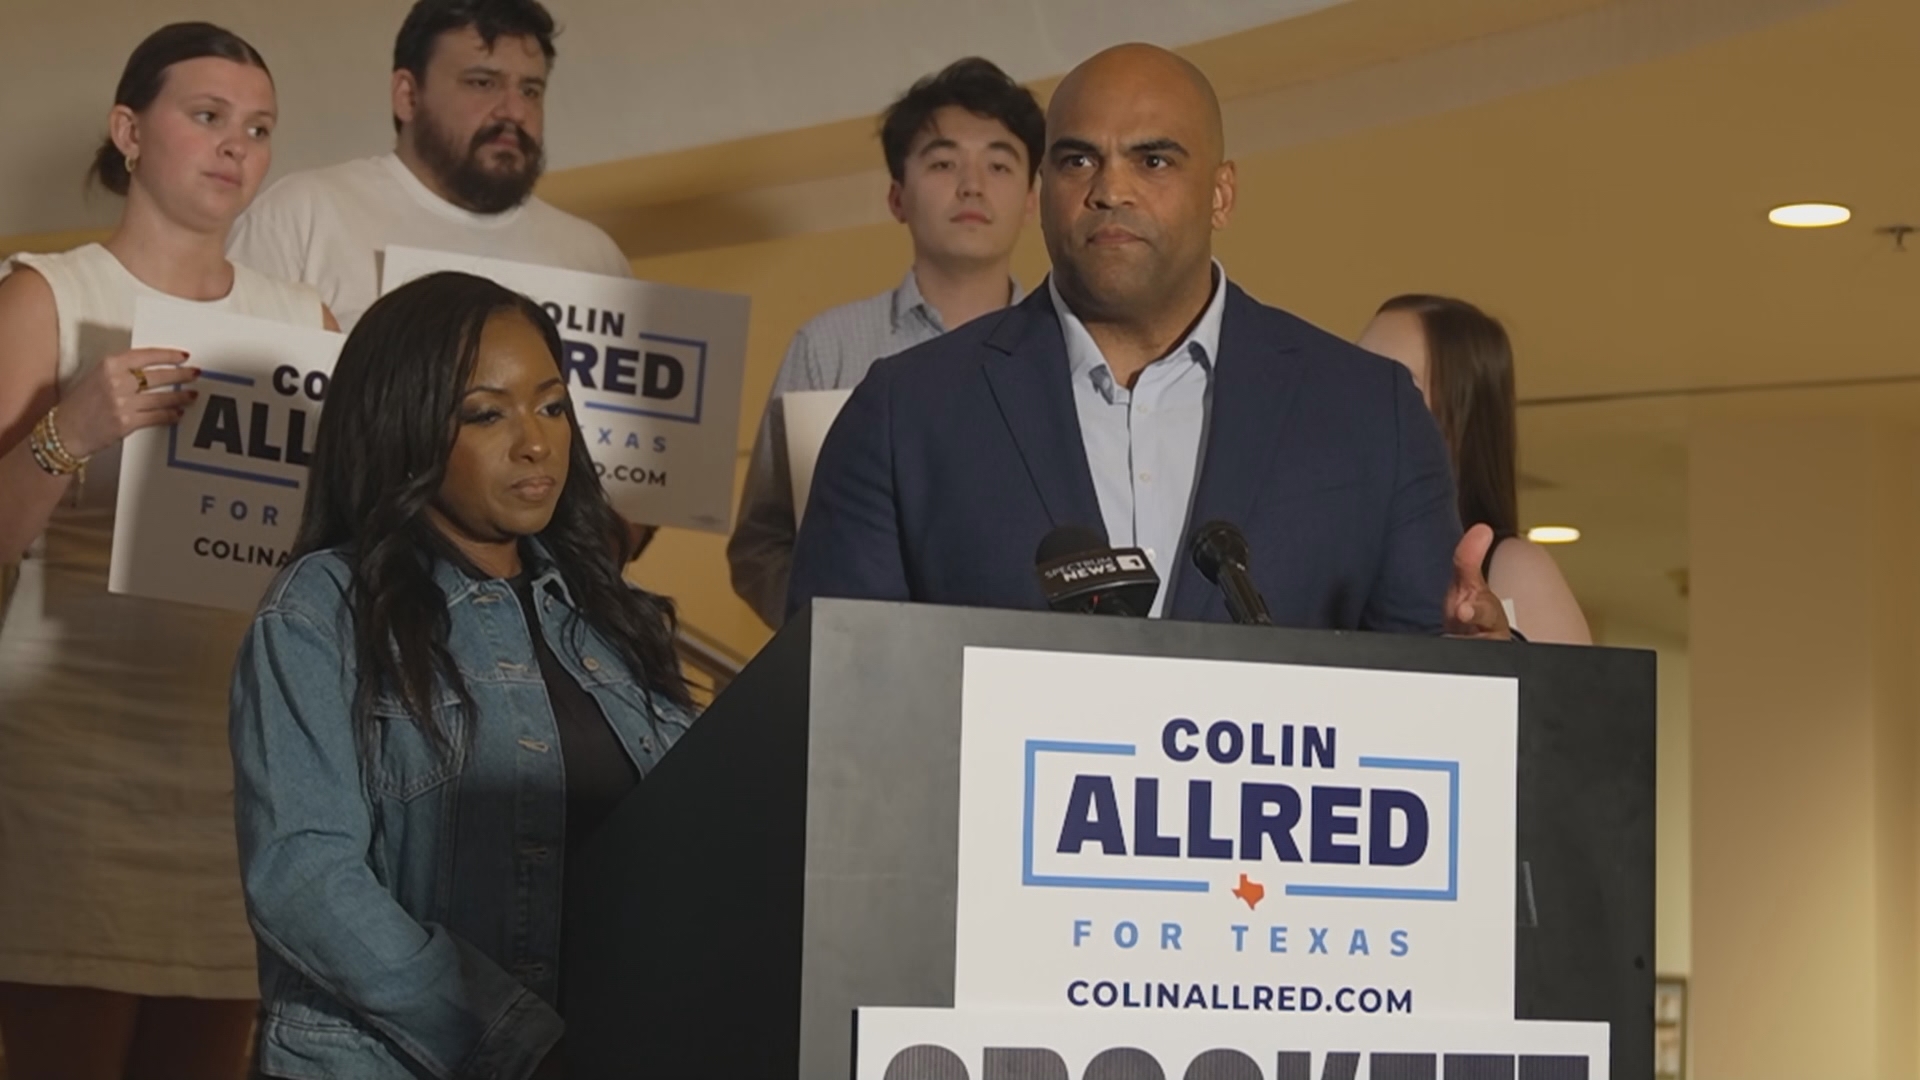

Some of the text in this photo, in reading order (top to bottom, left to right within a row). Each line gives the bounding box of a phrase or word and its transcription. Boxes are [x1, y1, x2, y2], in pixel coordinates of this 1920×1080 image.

[525, 296, 625, 338] OLIN
[272, 364, 330, 402] CO
[561, 339, 684, 401] RED
[193, 394, 315, 467] ALL
[580, 425, 667, 453] XAS
[201, 495, 279, 526] FOR
[1062, 563, 1117, 582] NEWS
[1161, 718, 1336, 769] COLIN
[1056, 774, 1429, 866] ALLRED
[1073, 920, 1409, 957] FOR TEXAS
[1067, 980, 1412, 1014] COLINALLRED.COM
